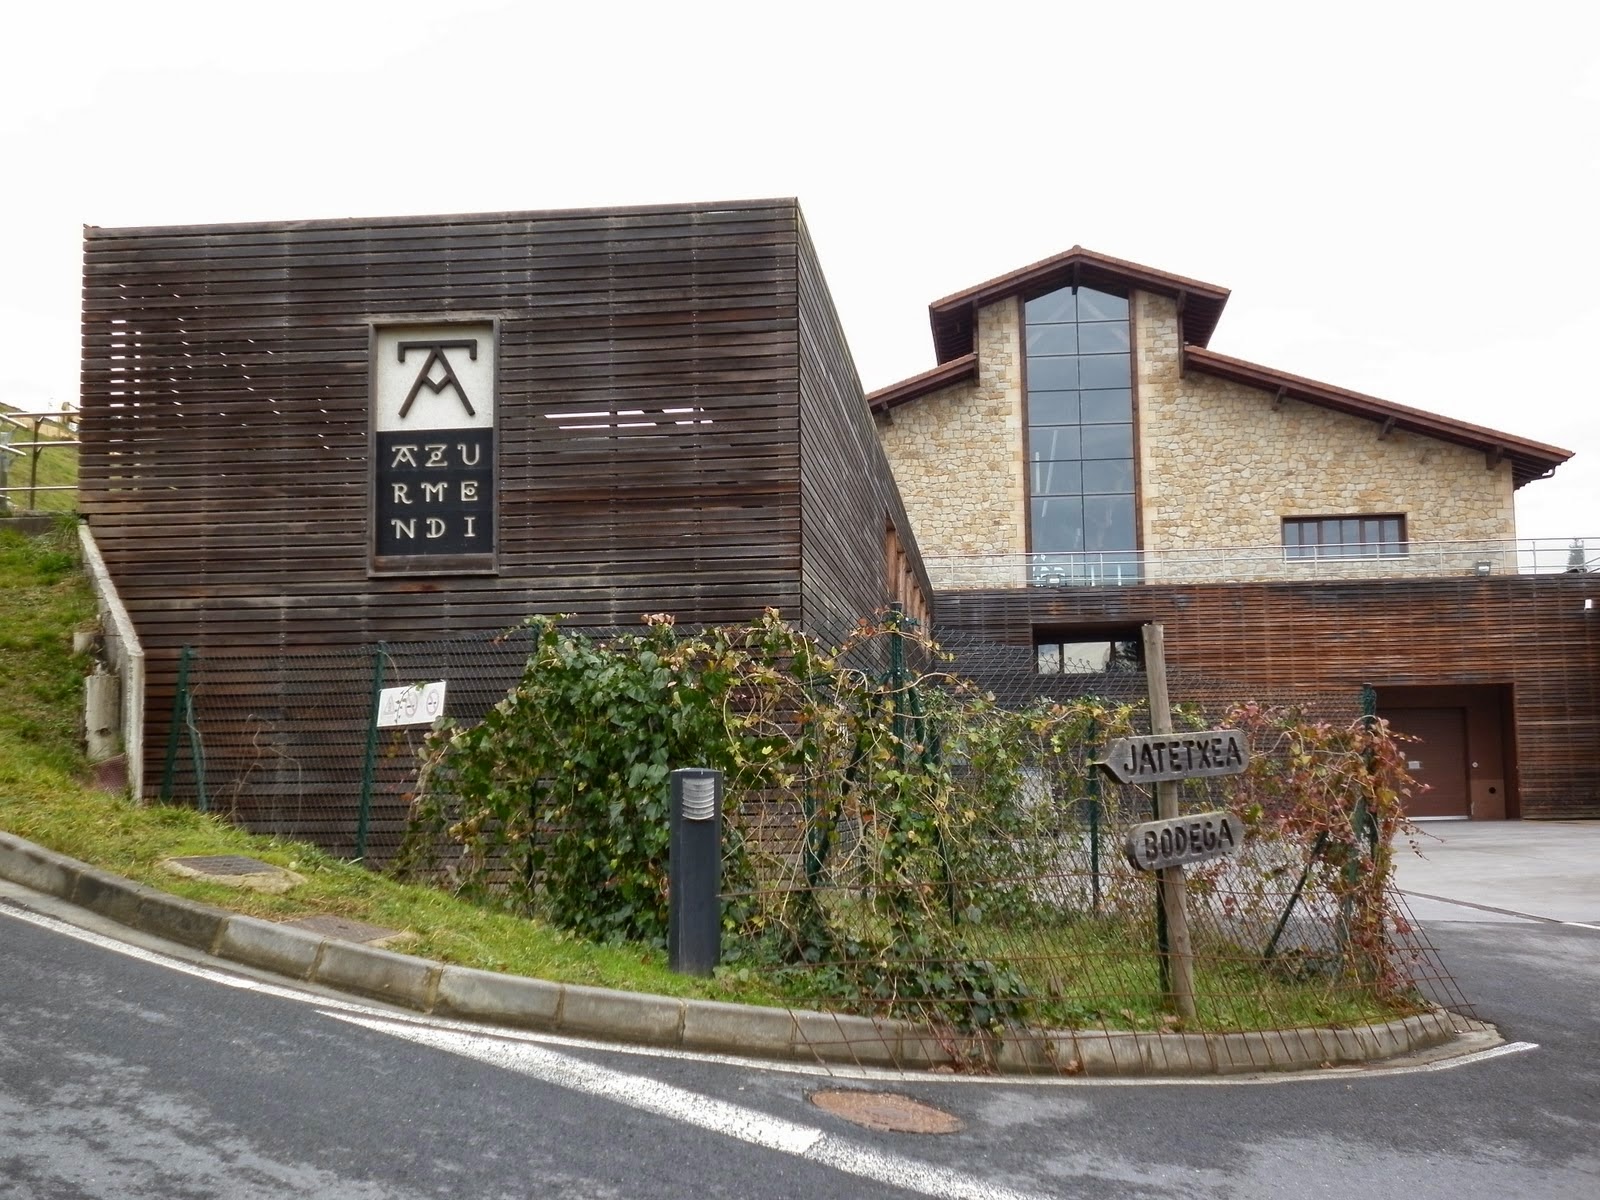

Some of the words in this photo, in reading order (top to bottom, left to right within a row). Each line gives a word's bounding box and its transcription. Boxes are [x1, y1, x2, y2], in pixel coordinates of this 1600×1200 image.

[392, 444, 480, 468] AZU
[392, 481, 478, 504] RME
[391, 516, 476, 539] NDI
[1123, 736, 1242, 776] JATETXEA
[1144, 818, 1235, 862] BODEGA
